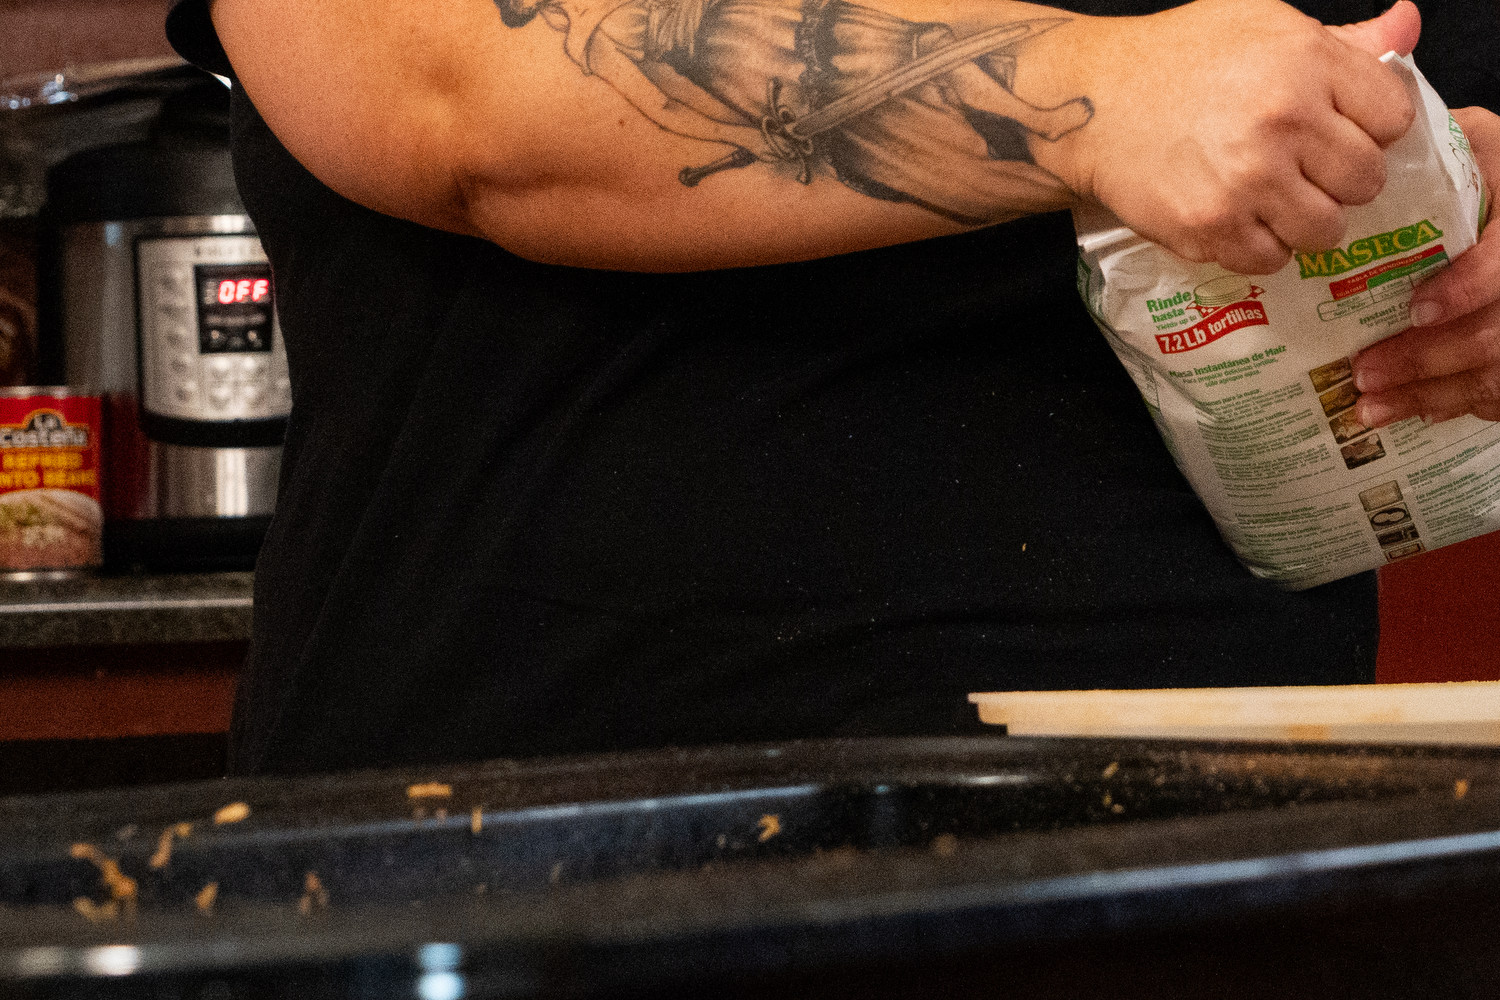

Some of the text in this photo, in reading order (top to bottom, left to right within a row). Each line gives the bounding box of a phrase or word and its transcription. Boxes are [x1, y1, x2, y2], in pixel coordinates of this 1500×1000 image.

[1300, 221, 1438, 276] MASECA
[218, 279, 270, 304] OFF
[1146, 291, 1192, 313] Rinde
[1152, 307, 1185, 323] hasta
[1208, 308, 1263, 335] tortillas
[1359, 305, 1397, 325] Instant
[1251, 352, 1264, 362] de
